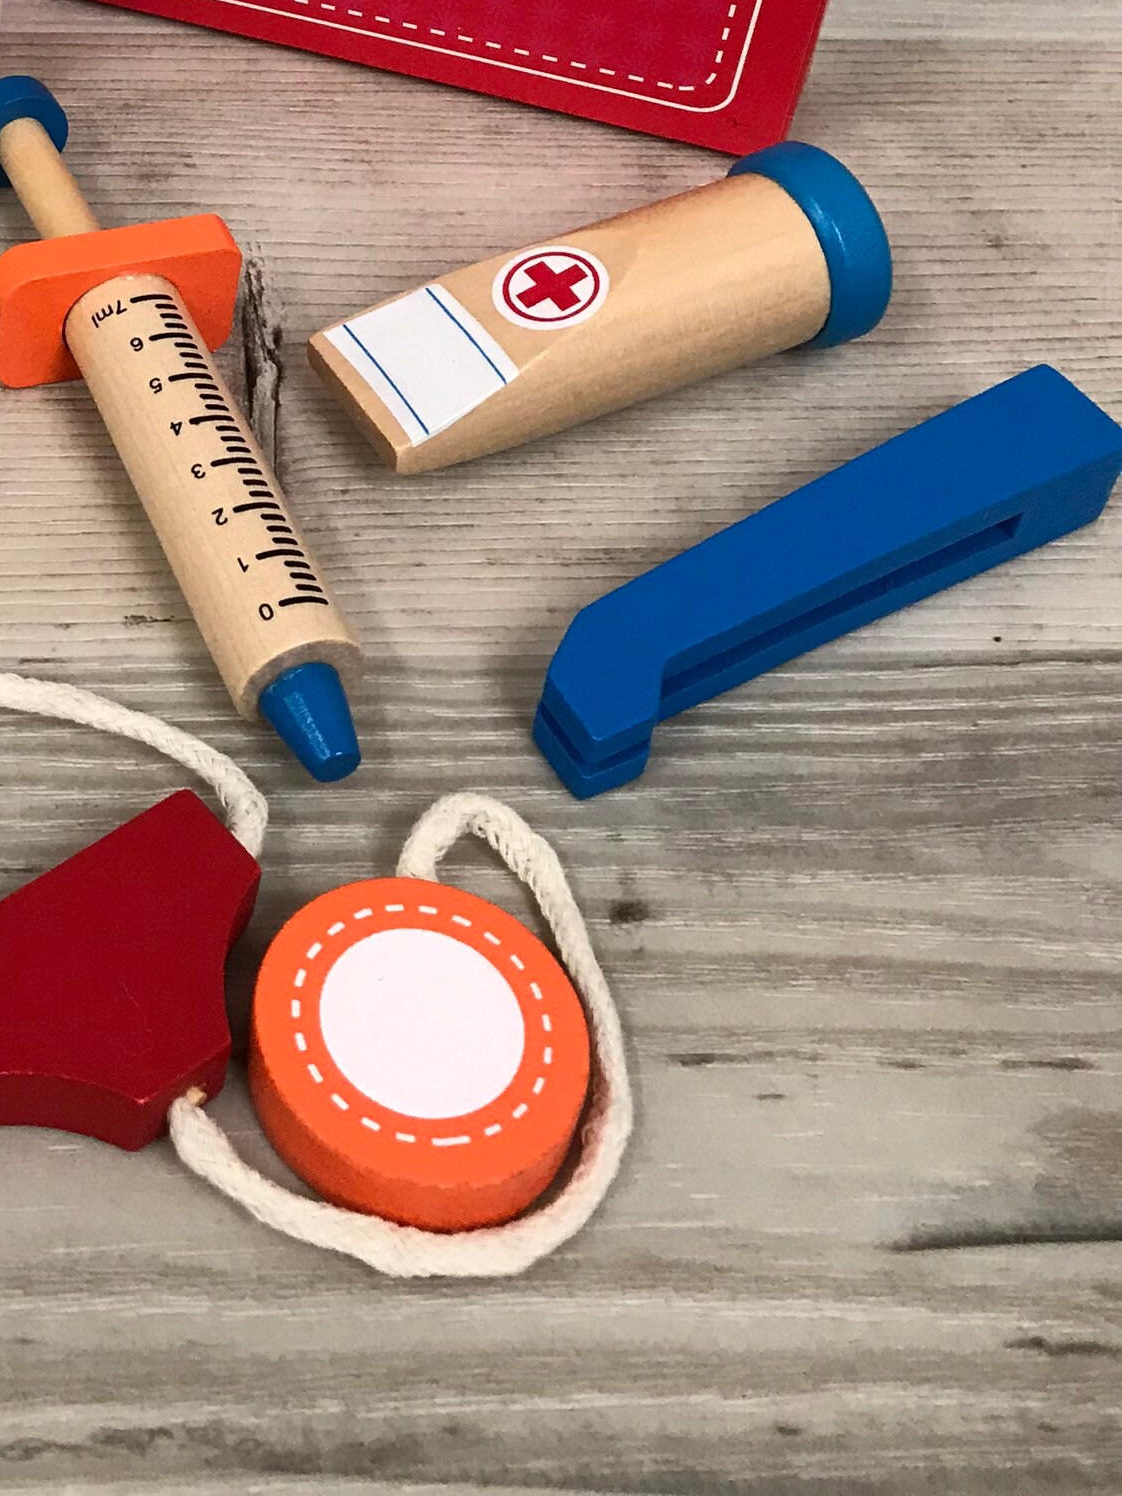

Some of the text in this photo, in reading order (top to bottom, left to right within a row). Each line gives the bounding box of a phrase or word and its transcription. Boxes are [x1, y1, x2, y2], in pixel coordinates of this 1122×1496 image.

[91, 299, 128, 330] 7ml
[129, 337, 144, 352] 6
[149, 377, 163, 394] 5
[169, 421, 183, 437] 4
[190, 463, 206, 480] 3
[211, 507, 228, 526] 2
[237, 557, 249, 573] 1
[258, 603, 274, 621] 0
